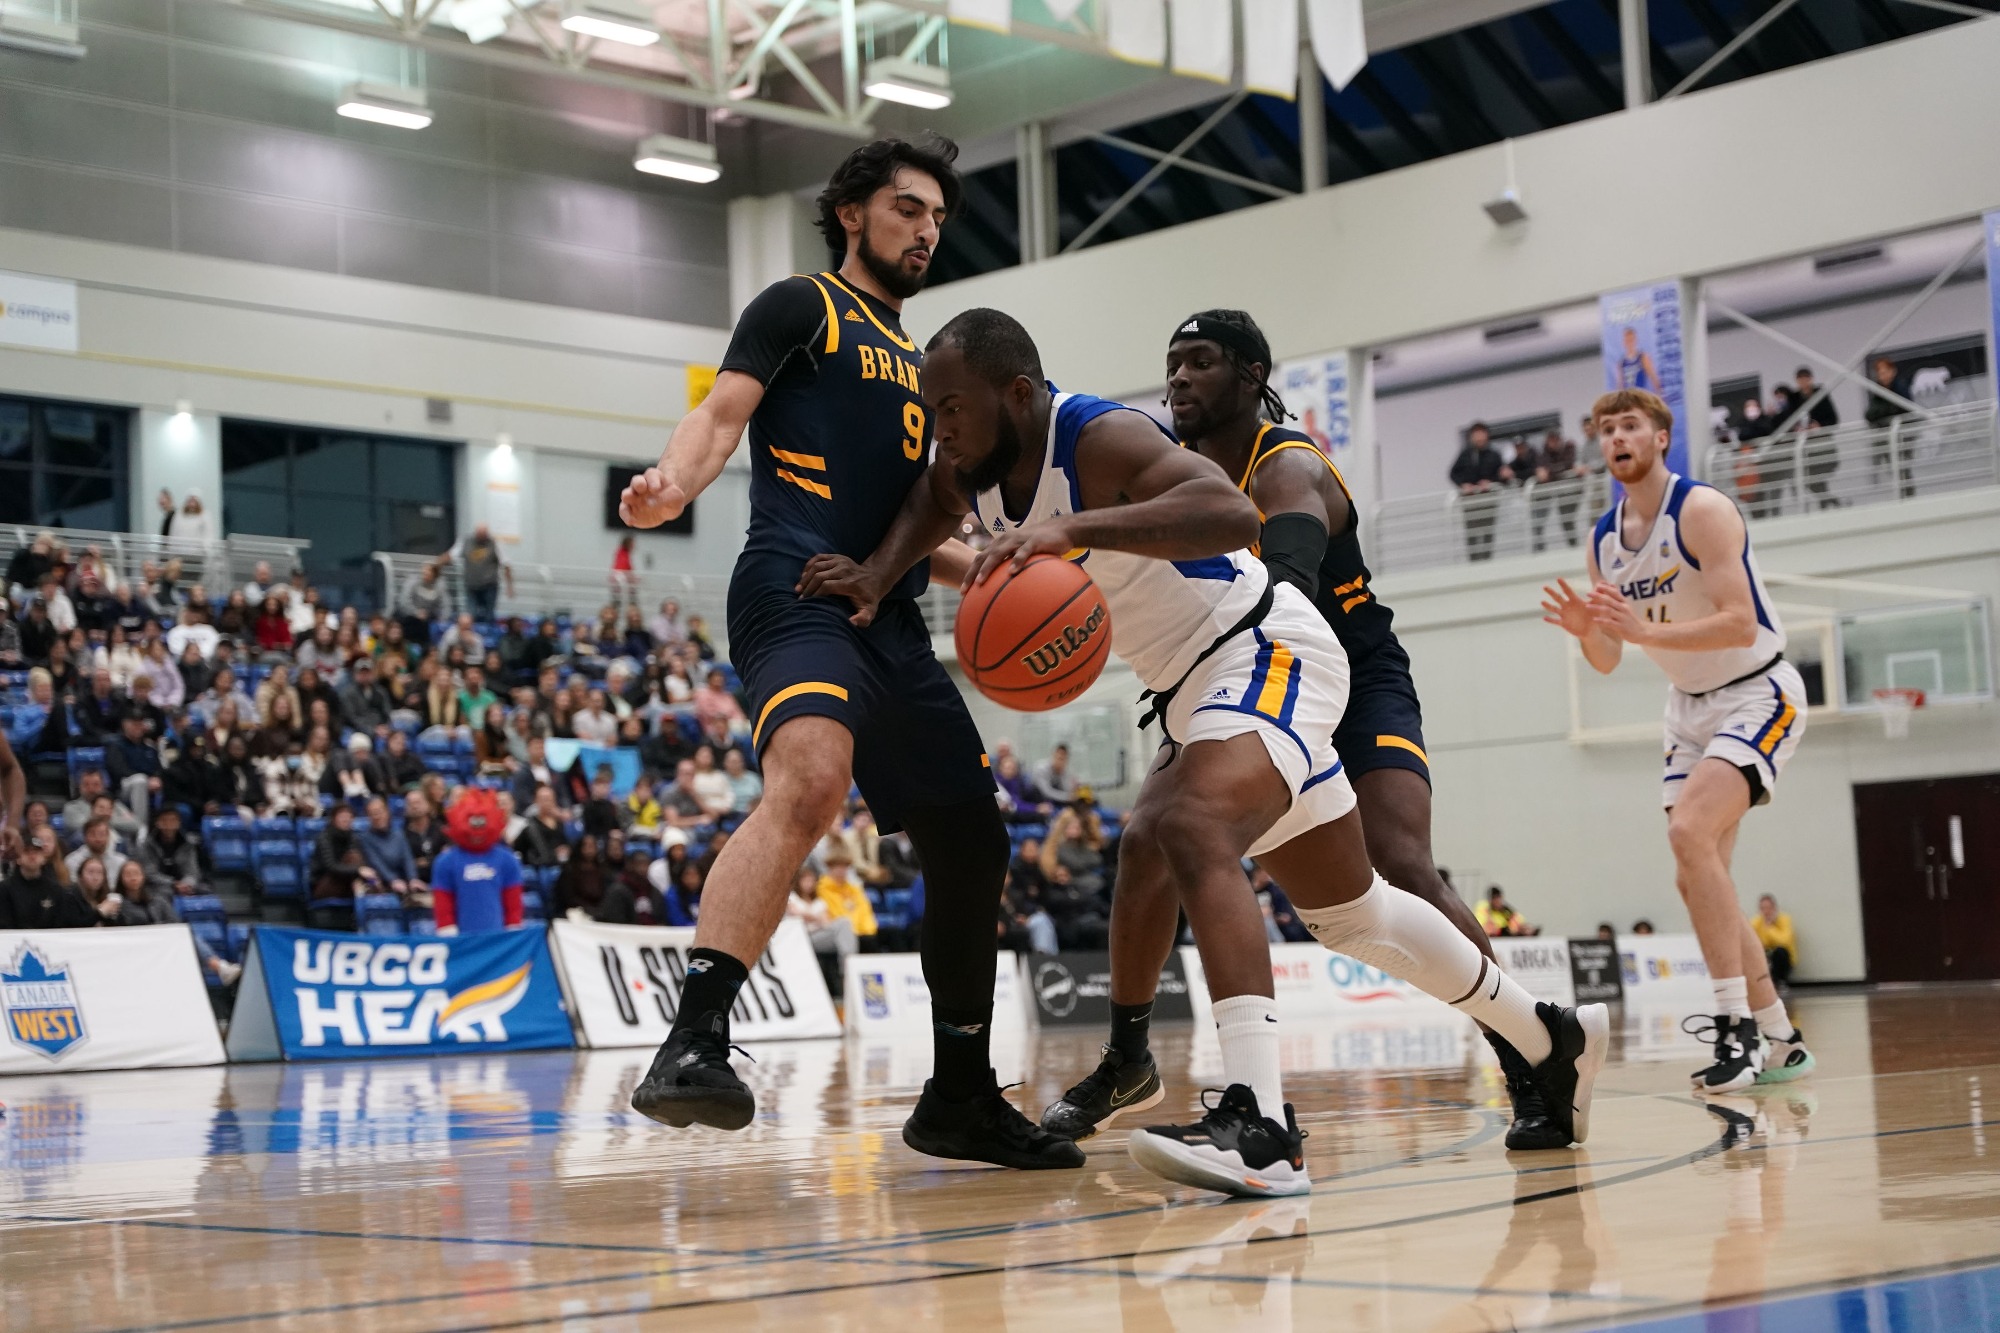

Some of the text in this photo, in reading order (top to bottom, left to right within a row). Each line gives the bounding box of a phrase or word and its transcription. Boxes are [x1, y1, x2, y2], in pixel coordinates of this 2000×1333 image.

[7, 302, 71, 327] campus
[857, 345, 924, 398] BRAN
[903, 401, 926, 462] 9
[1021, 602, 1107, 678] Wilson
[293, 939, 450, 986] UBCO
[1674, 960, 1708, 978] camp
[5, 985, 71, 1005] CANADA
[294, 968, 531, 1047] HEAT
[12, 1009, 78, 1042] WEST
